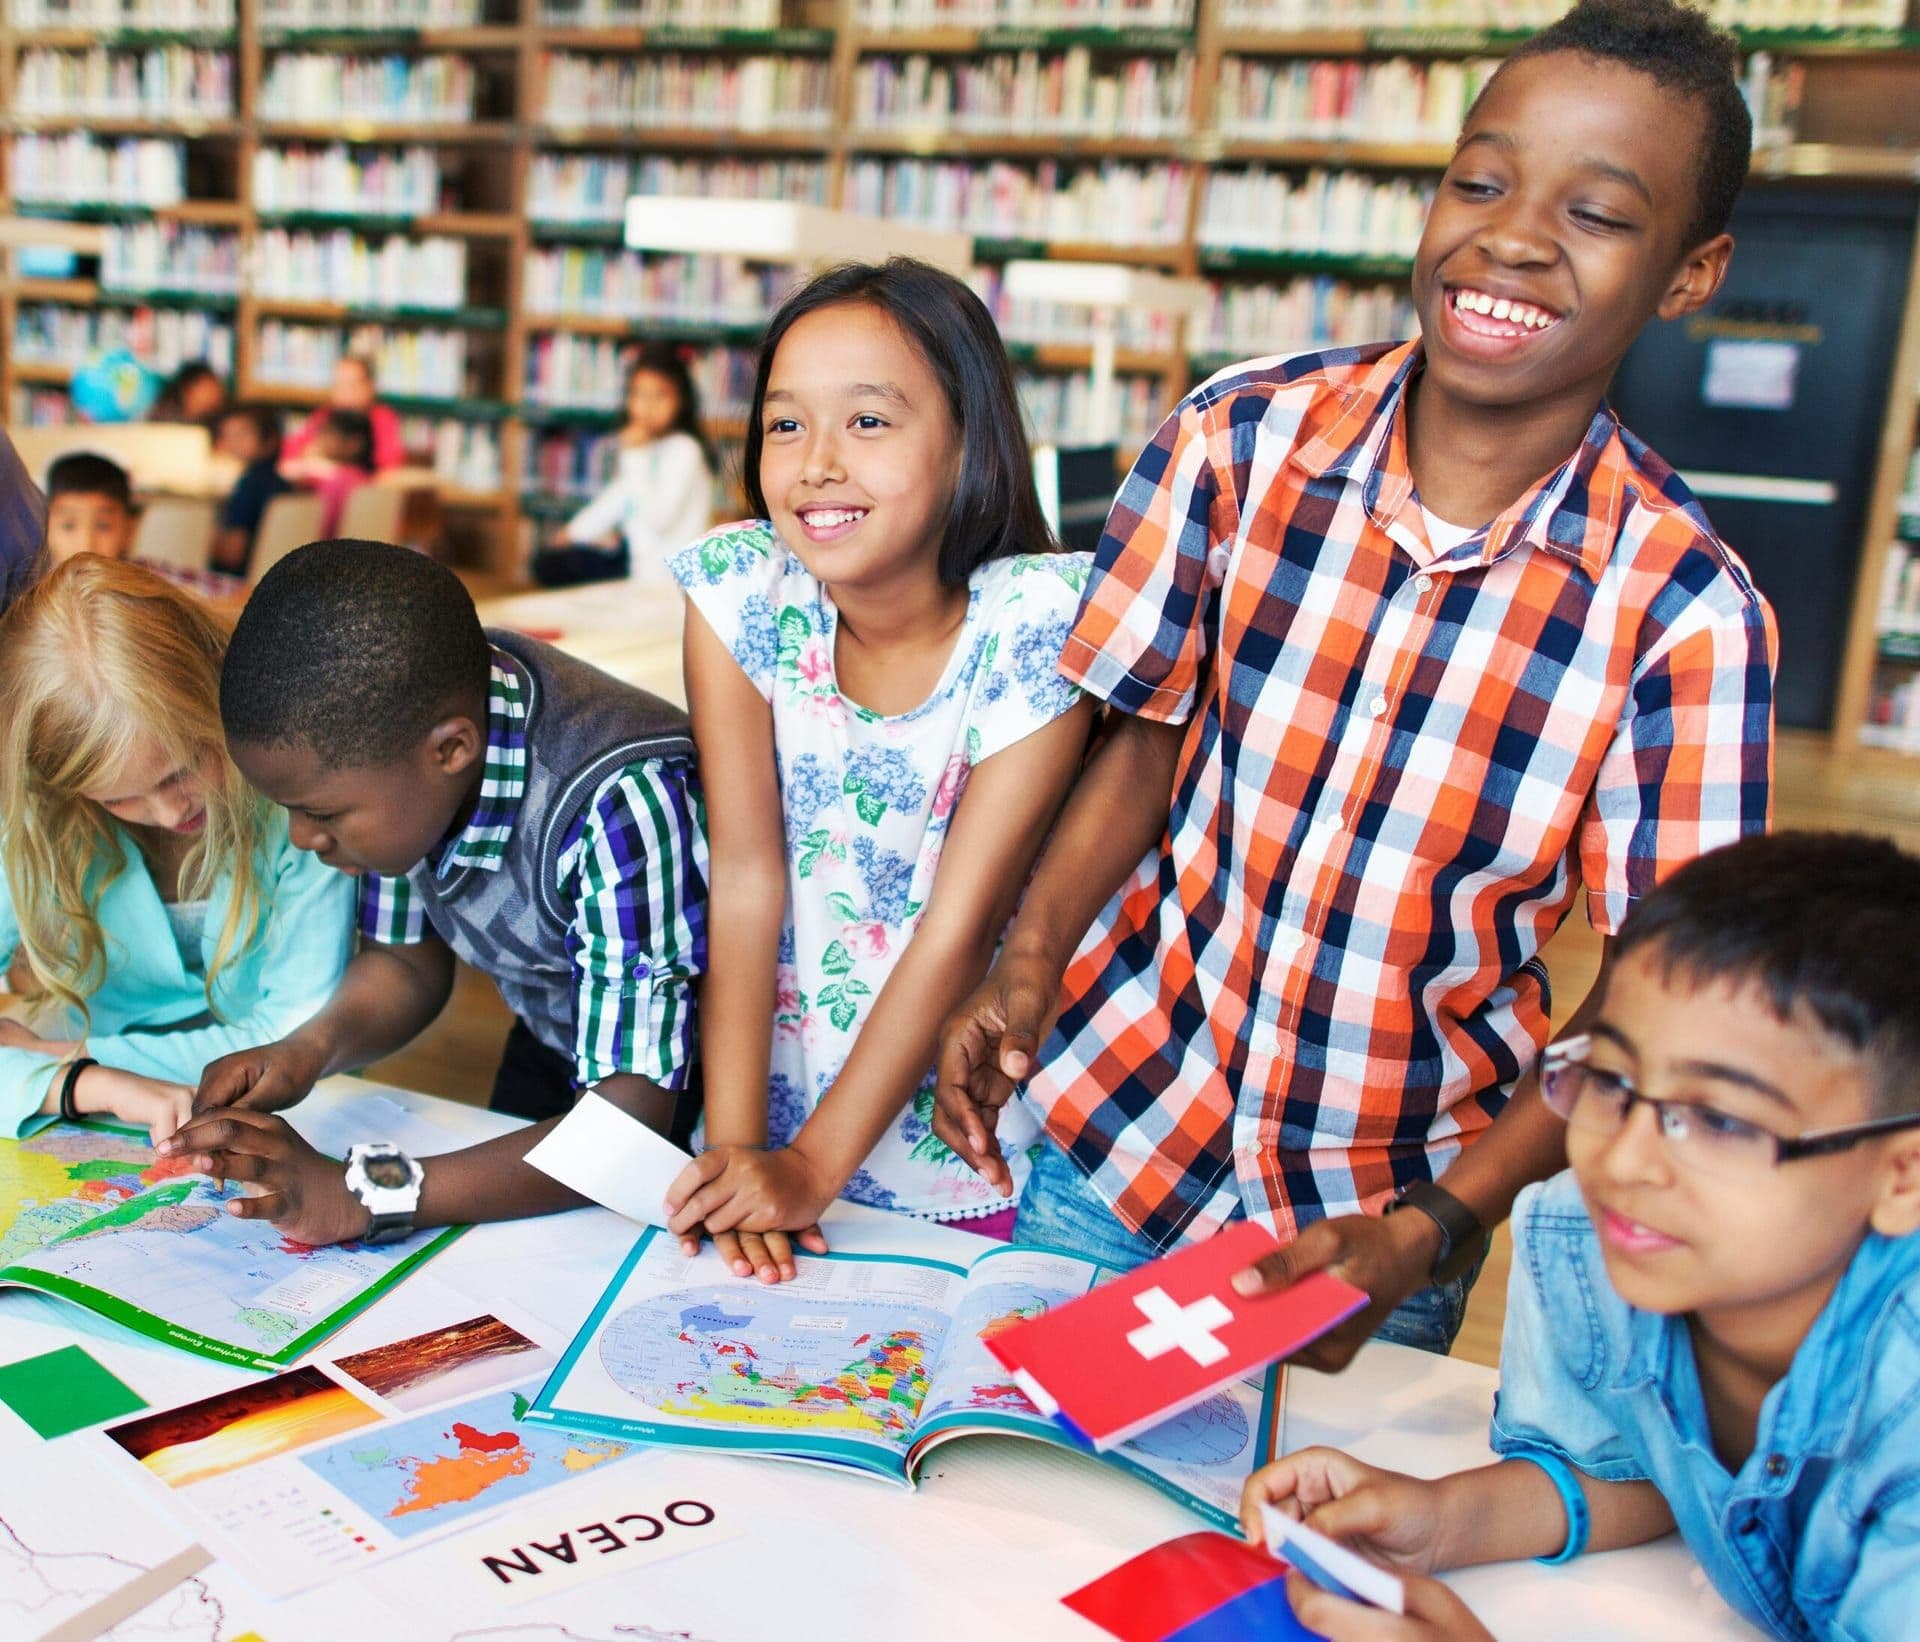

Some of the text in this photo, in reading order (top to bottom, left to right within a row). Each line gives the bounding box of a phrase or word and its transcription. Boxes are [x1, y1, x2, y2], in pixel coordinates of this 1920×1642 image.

[168, 1330, 249, 1361] Northern Europe
[622, 1424, 656, 1434] World
[1190, 1500, 1225, 1523] World
[481, 1500, 716, 1584] OCEAN
